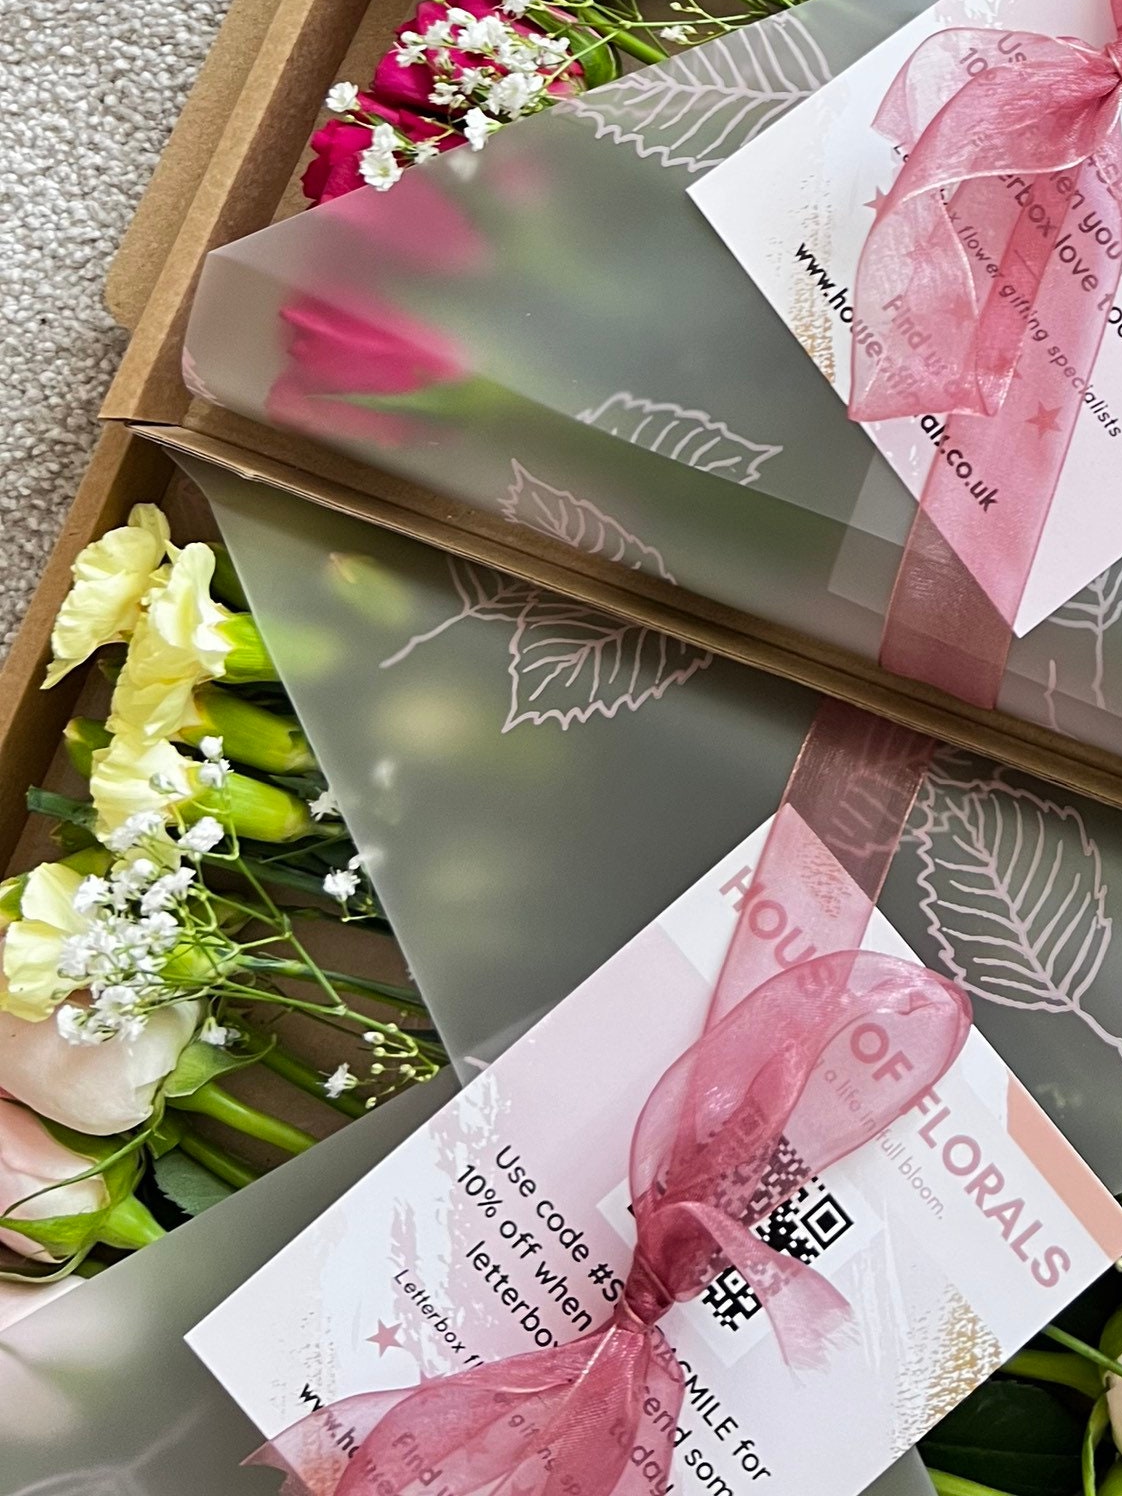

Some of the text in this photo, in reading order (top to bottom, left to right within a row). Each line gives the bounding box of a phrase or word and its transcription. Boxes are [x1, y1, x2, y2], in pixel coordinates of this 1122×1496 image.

[1052, 232, 1100, 293] love
[1047, 345, 1120, 437] specialists
[718, 864, 856, 1020] HOUS
[850, 1023, 914, 1080] OF
[899, 1083, 1072, 1286] FLORALS
[875, 1131, 905, 1160] full
[898, 1156, 945, 1220] bloom.
[458, 1164, 503, 1217] 10%
[501, 1223, 542, 1259] off
[534, 1260, 593, 1331] when
[466, 1239, 556, 1349] letterbo
[394, 1269, 465, 1353] Letterbox
[496, 1144, 535, 1197] Use
[536, 1201, 588, 1263] code
[733, 1440, 770, 1479] for
